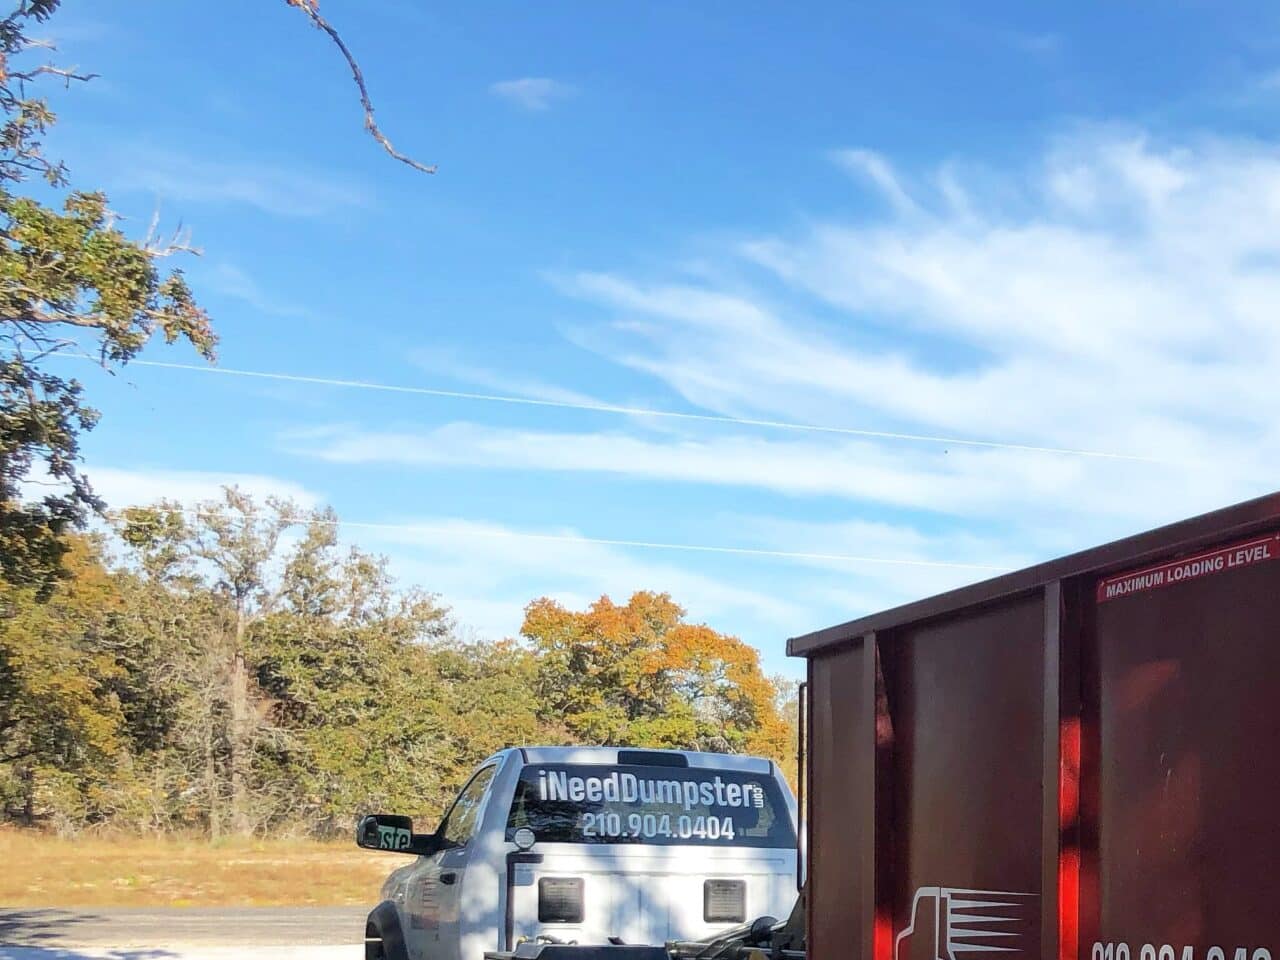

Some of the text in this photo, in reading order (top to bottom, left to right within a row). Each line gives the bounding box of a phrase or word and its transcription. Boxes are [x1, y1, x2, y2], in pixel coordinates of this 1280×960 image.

[1106, 544, 1271, 598] MAXIMUM LOADING LEVEL
[539, 770, 754, 811] iNeedDumpster
[582, 812, 735, 840] 210.904.0404
